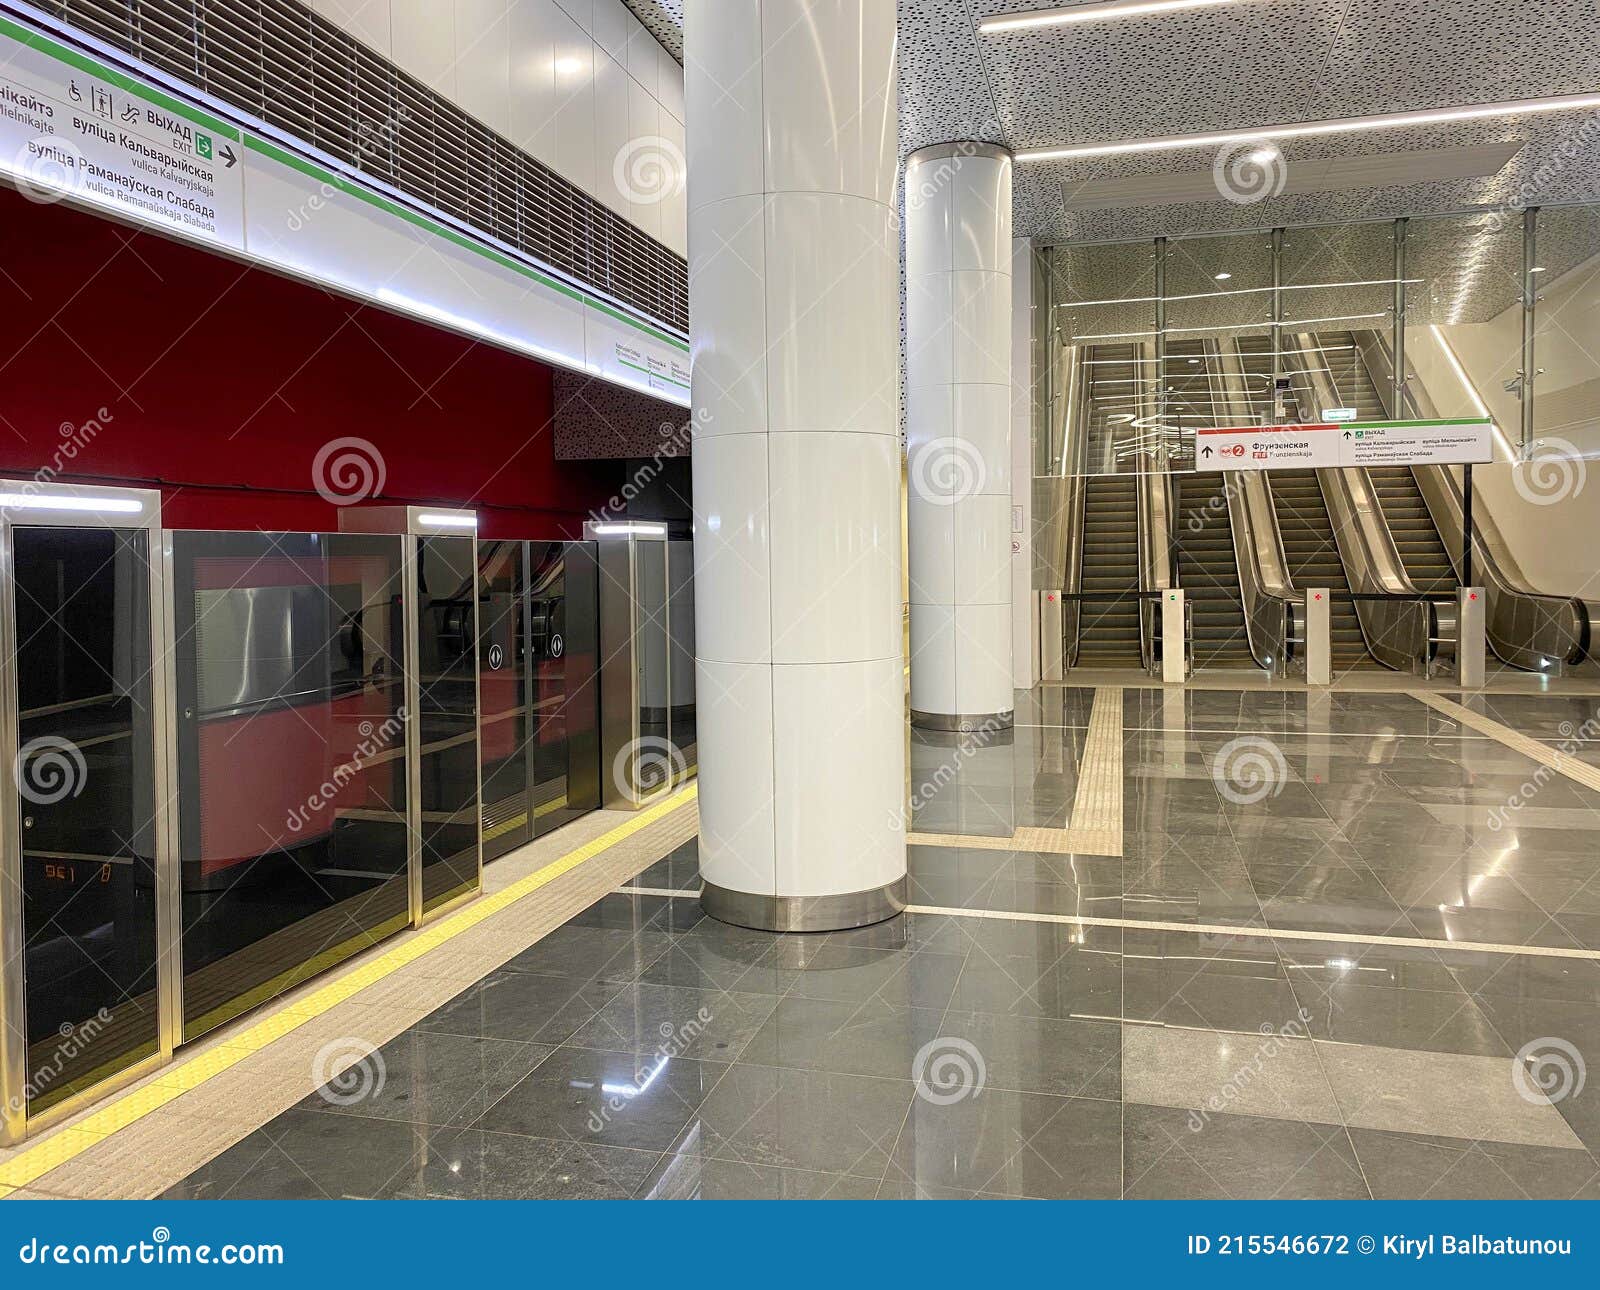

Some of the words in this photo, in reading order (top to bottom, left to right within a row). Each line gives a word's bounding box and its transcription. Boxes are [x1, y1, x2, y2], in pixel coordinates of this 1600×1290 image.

[146, 109, 192, 143] ВЫХАД
[73, 117, 116, 144] вуліца
[119, 131, 214, 182] Кальварыйская
[172, 138, 192, 155] EXIT
[28, 141, 75, 168] вуліца
[79, 157, 164, 201] Раманаўская
[166, 190, 215, 219] Слабада
[131, 157, 158, 175] vulica
[86, 179, 115, 198] vulica
[183, 212, 216, 233] Slabada
[1252, 442, 1309, 451] Фрунзенская
